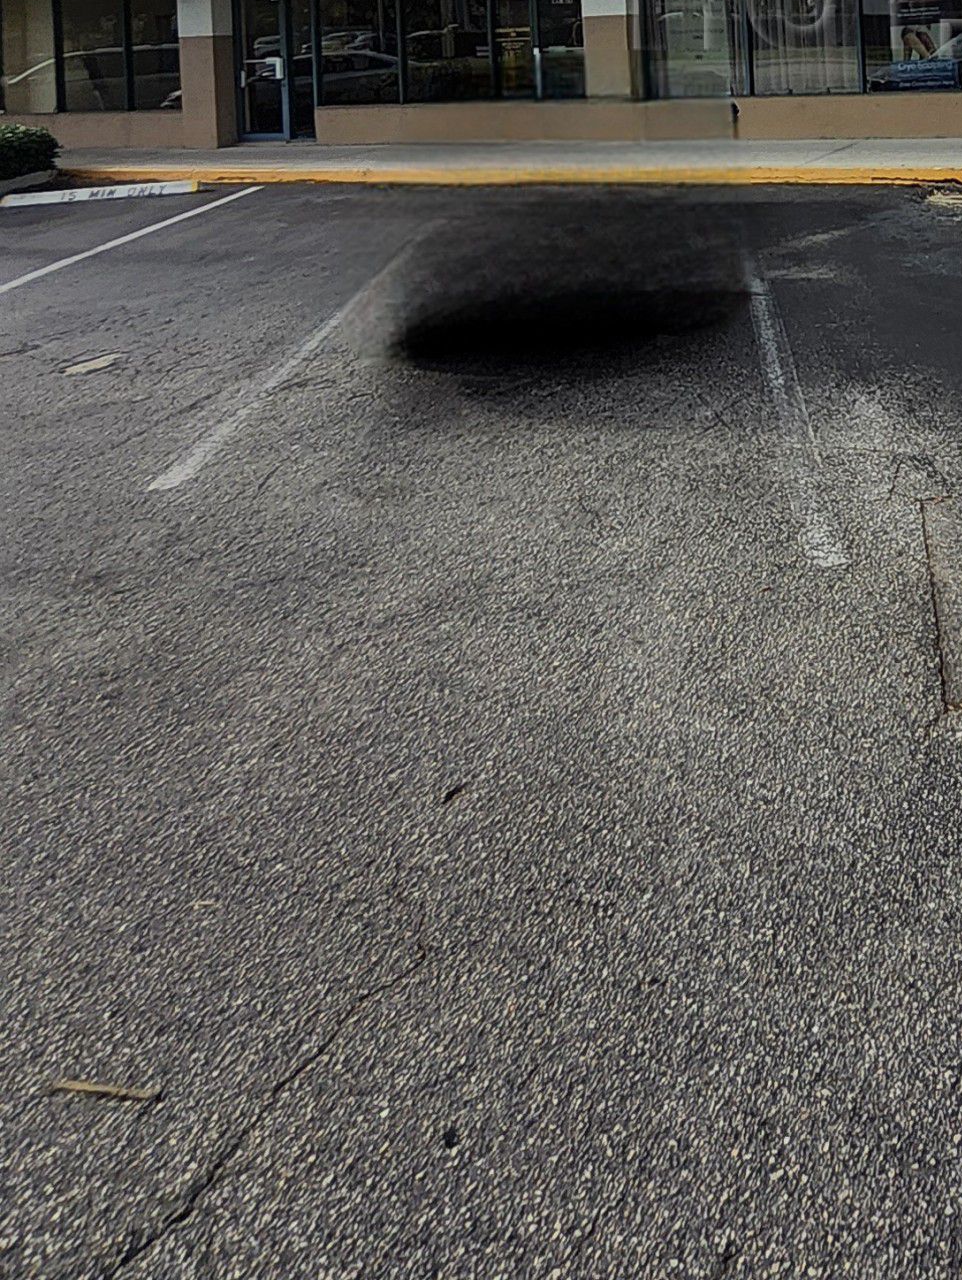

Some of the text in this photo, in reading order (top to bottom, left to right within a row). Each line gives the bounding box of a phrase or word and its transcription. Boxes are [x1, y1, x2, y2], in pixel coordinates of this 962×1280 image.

[61, 184, 168, 201] 15 MIN ONLY
